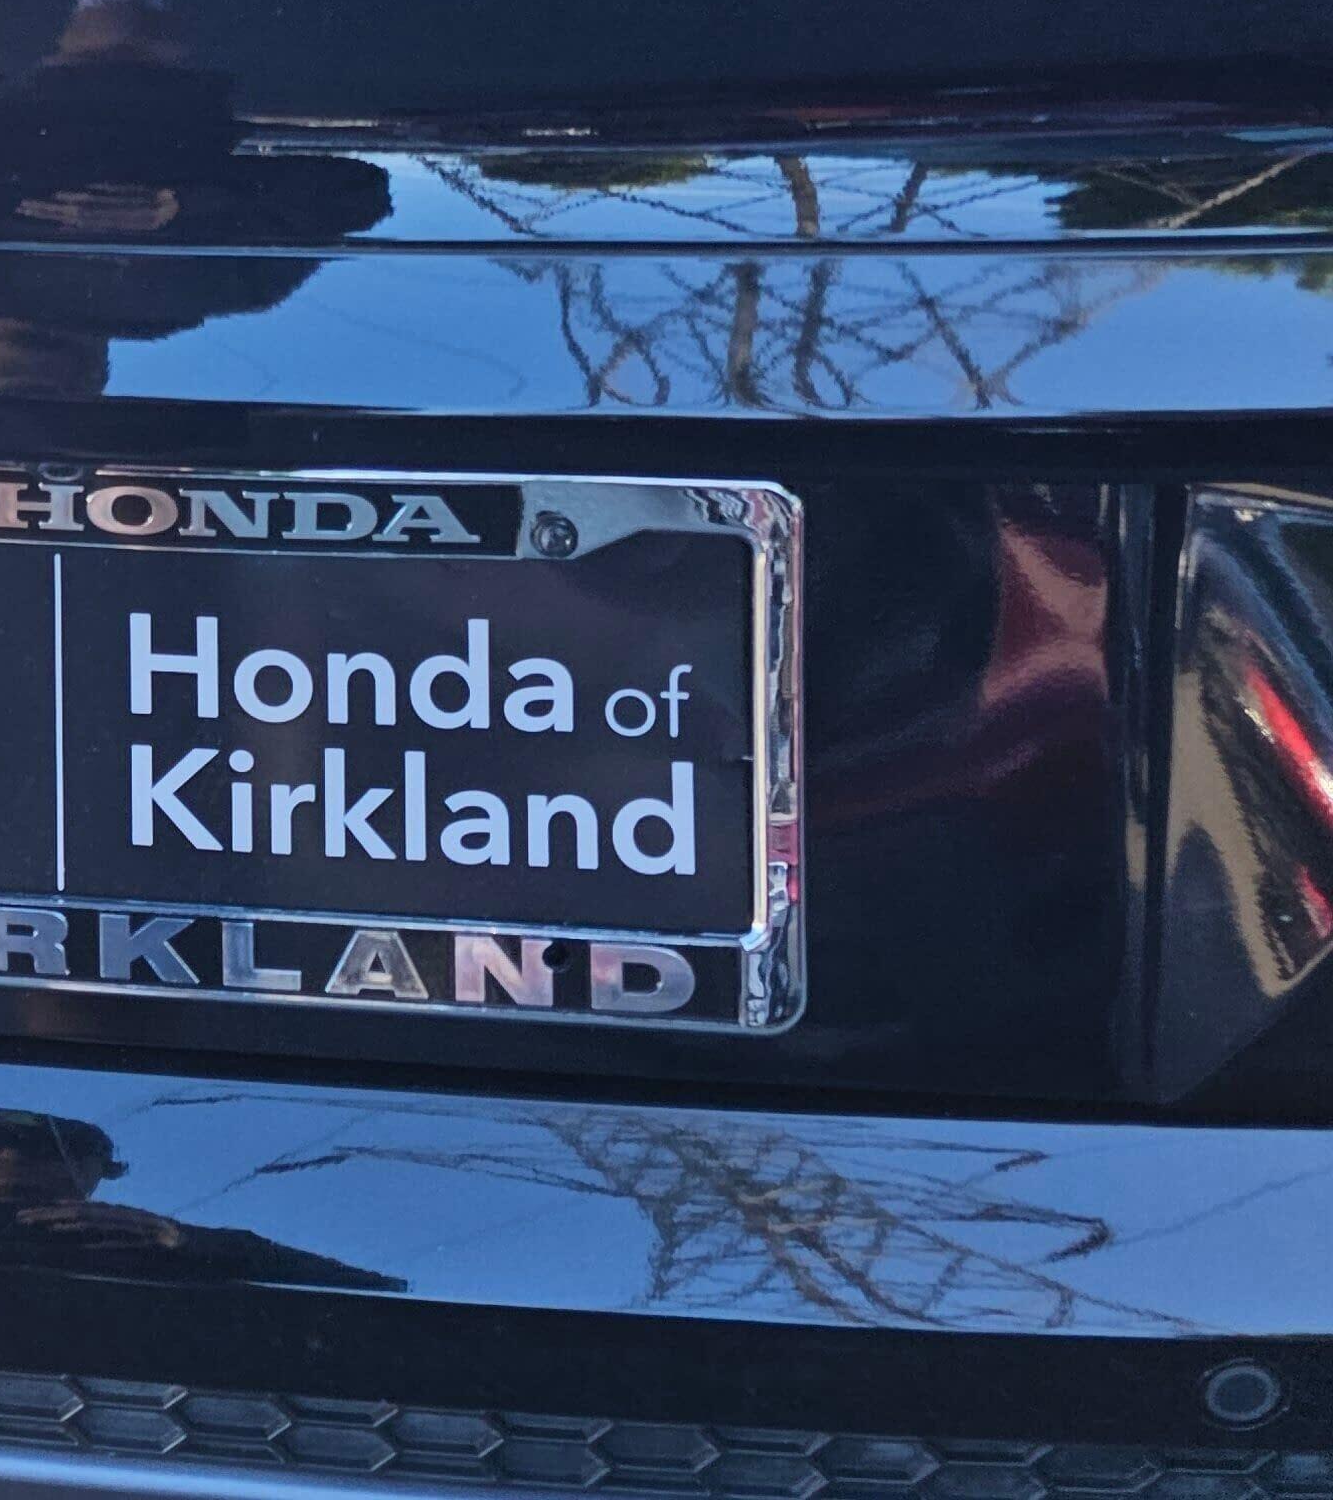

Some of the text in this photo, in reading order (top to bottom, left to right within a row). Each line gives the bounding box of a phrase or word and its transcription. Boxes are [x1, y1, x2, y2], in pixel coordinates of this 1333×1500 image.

[130, 612, 693, 738] Honda of
[131, 744, 696, 875] Kirkland
